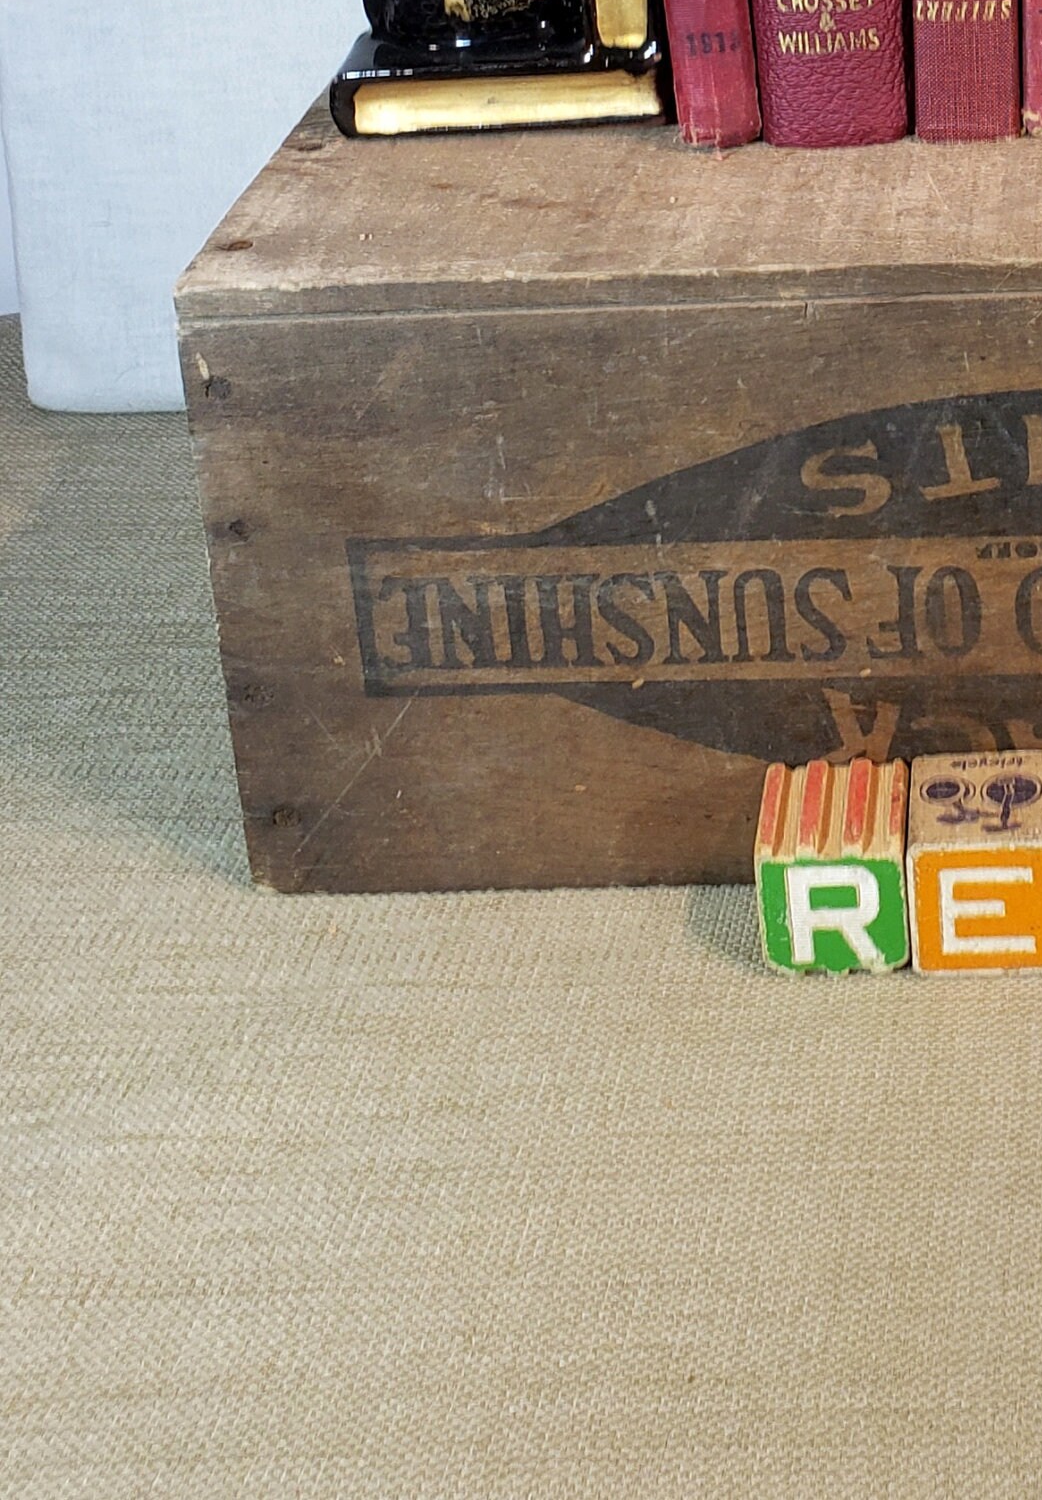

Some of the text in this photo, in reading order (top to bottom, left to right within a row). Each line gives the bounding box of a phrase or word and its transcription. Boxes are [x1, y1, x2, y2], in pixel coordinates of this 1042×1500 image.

[777, 27, 881, 55] WILLIAMS
[819, 11, 837, 32] &
[376, 567, 855, 670] SUNSHINE
[866, 563, 983, 662] OF
